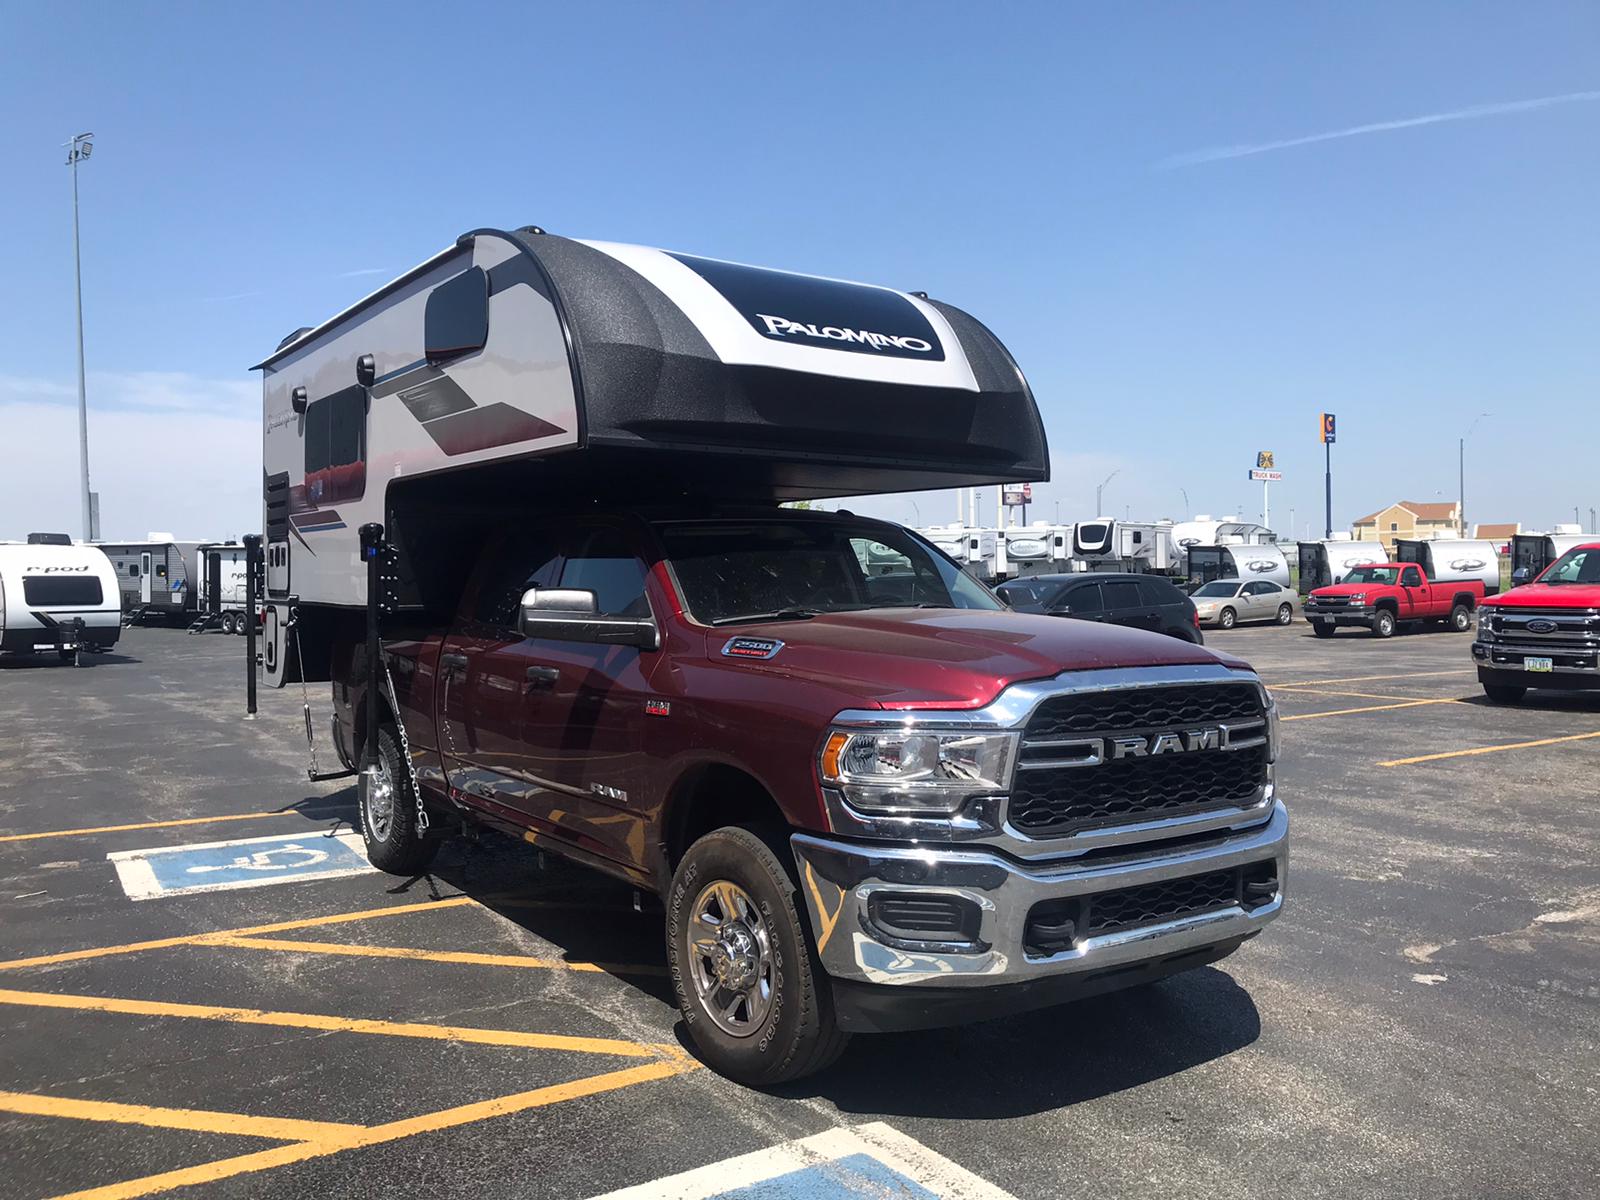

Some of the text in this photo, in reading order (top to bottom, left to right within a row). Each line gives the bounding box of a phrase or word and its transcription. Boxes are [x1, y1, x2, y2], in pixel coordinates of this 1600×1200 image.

[756, 314, 932, 351] PALOMINO
[735, 641, 773, 650] 2500
[1112, 729, 1219, 759] RAM
[591, 782, 628, 801] RAM
